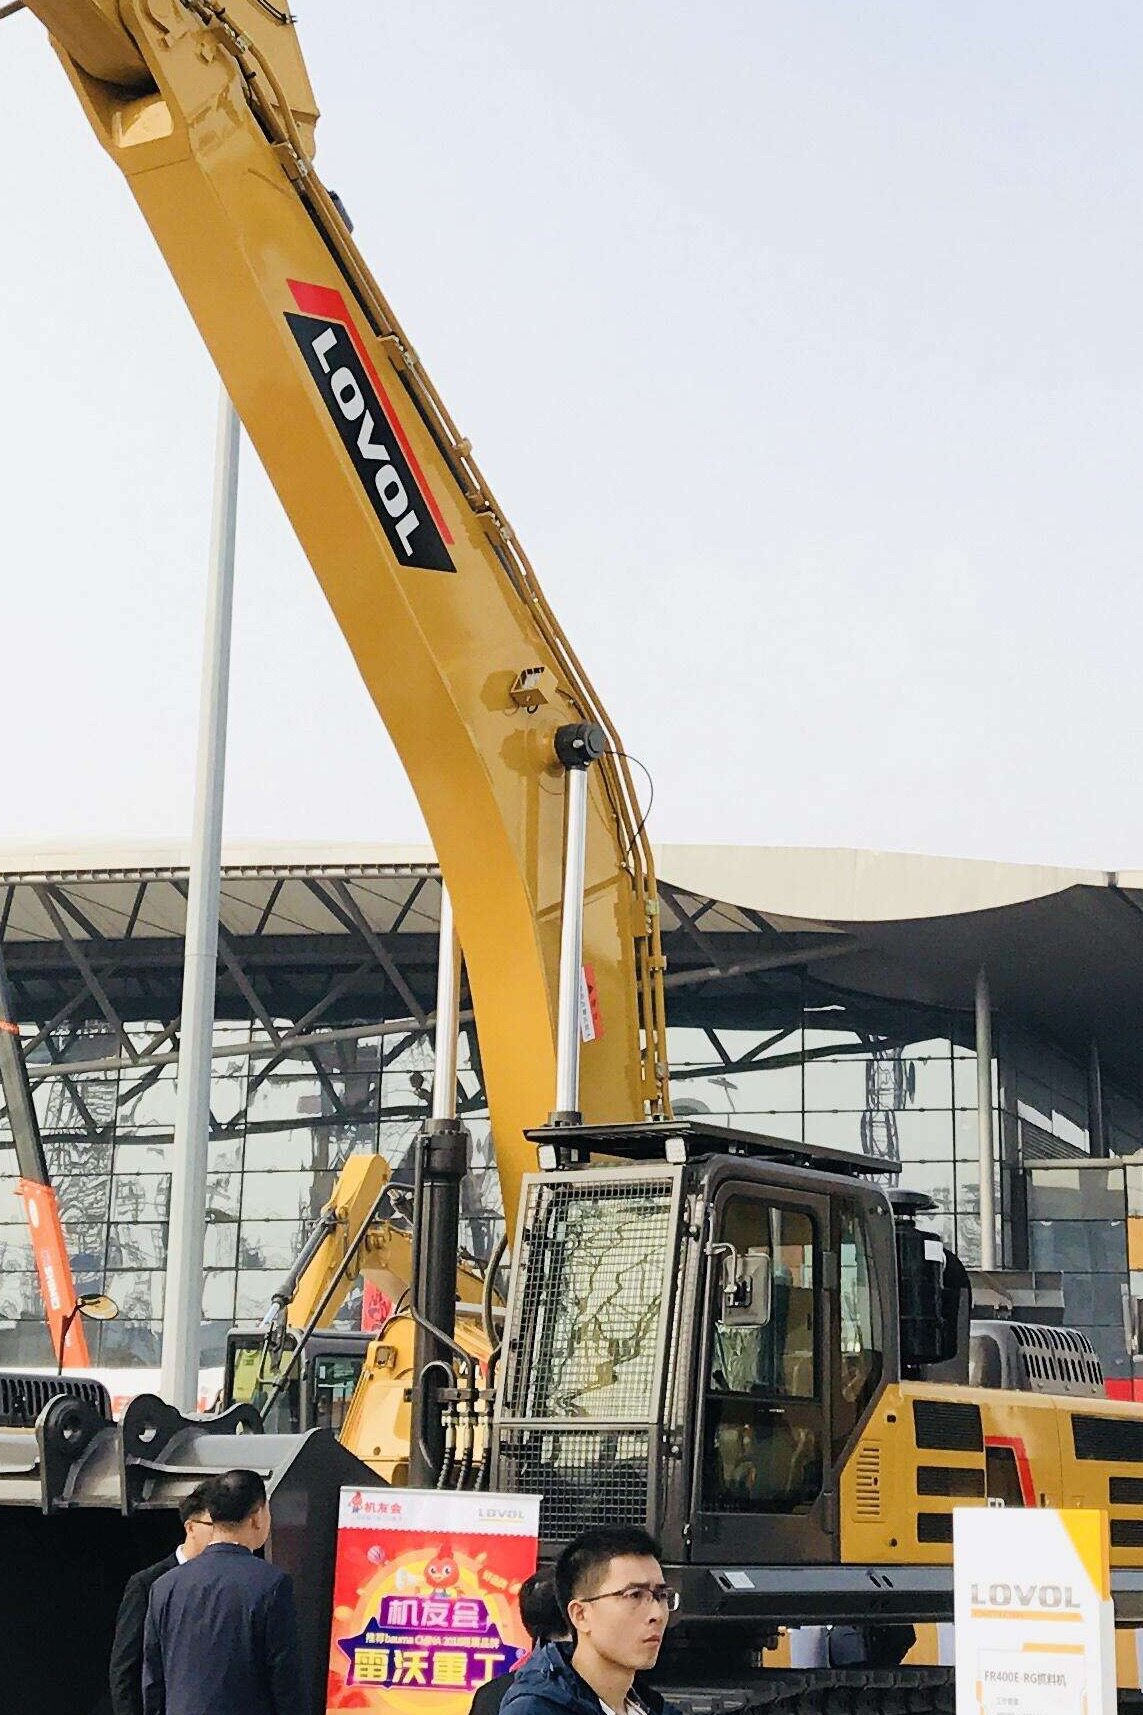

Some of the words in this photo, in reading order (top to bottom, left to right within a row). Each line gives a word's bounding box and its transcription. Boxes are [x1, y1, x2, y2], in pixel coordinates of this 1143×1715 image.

[311, 326, 420, 557] LOVOL
[364, 1501, 403, 1515] 机友会
[970, 1584, 1081, 1608] LOVOL
[387, 1599, 480, 1629] 机友会
[354, 1648, 506, 1686] 雷沃重工
